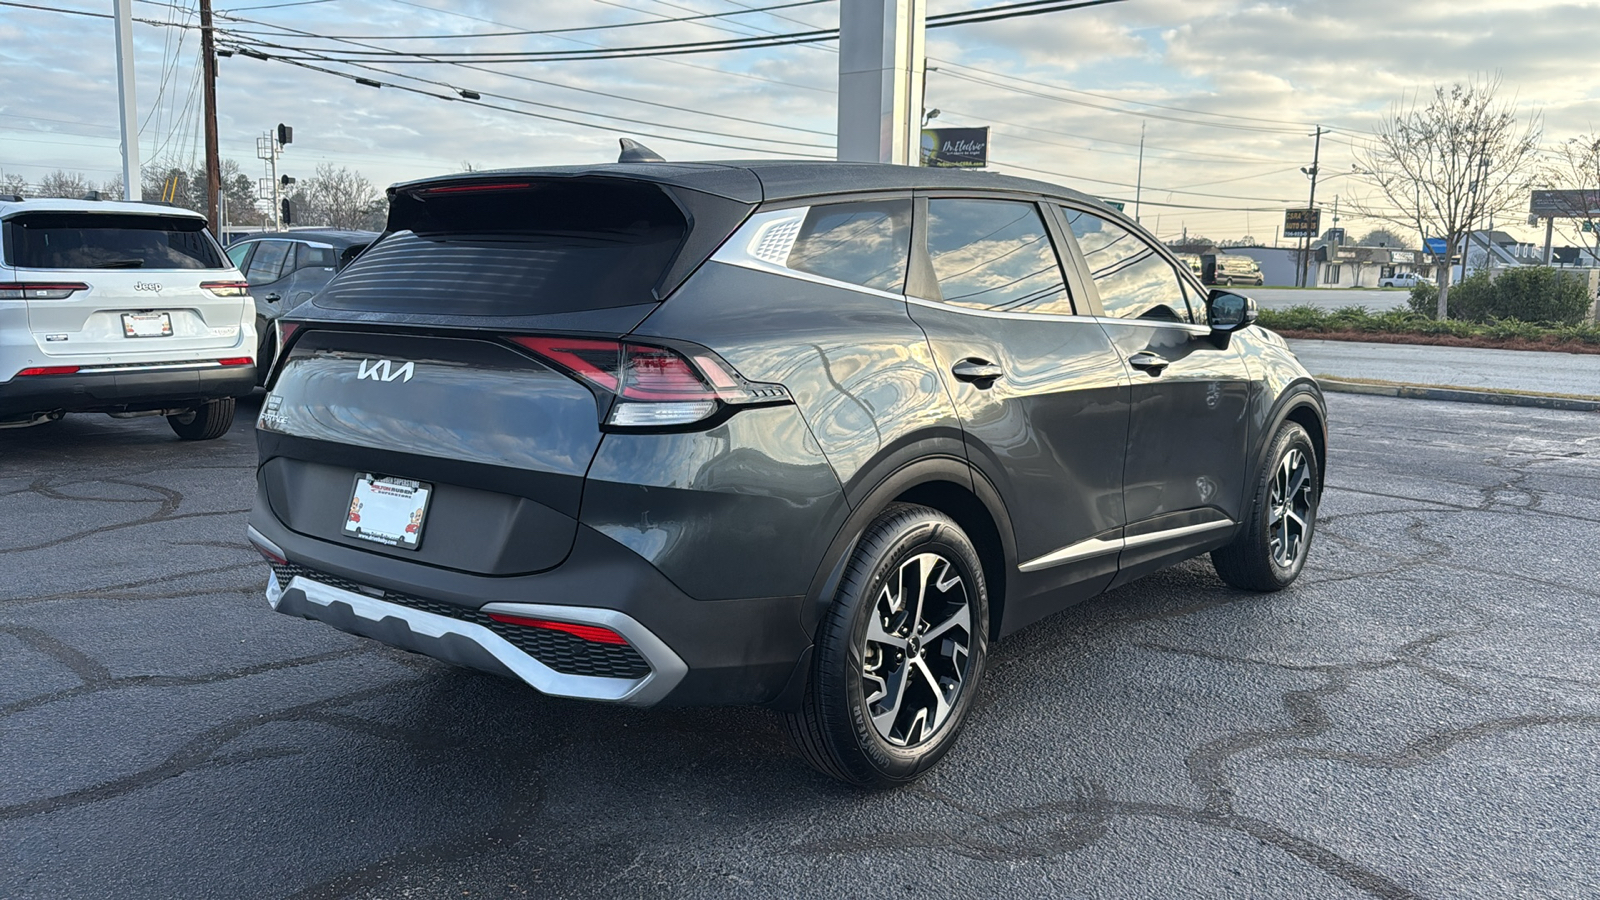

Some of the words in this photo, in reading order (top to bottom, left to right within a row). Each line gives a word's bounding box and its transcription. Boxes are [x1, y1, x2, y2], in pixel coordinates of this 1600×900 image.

[134, 281, 162, 291] Jeep
[357, 358, 415, 384] KIA
[391, 487, 413, 495] RUBEN
[853, 705, 890, 768] GOODYEAR
